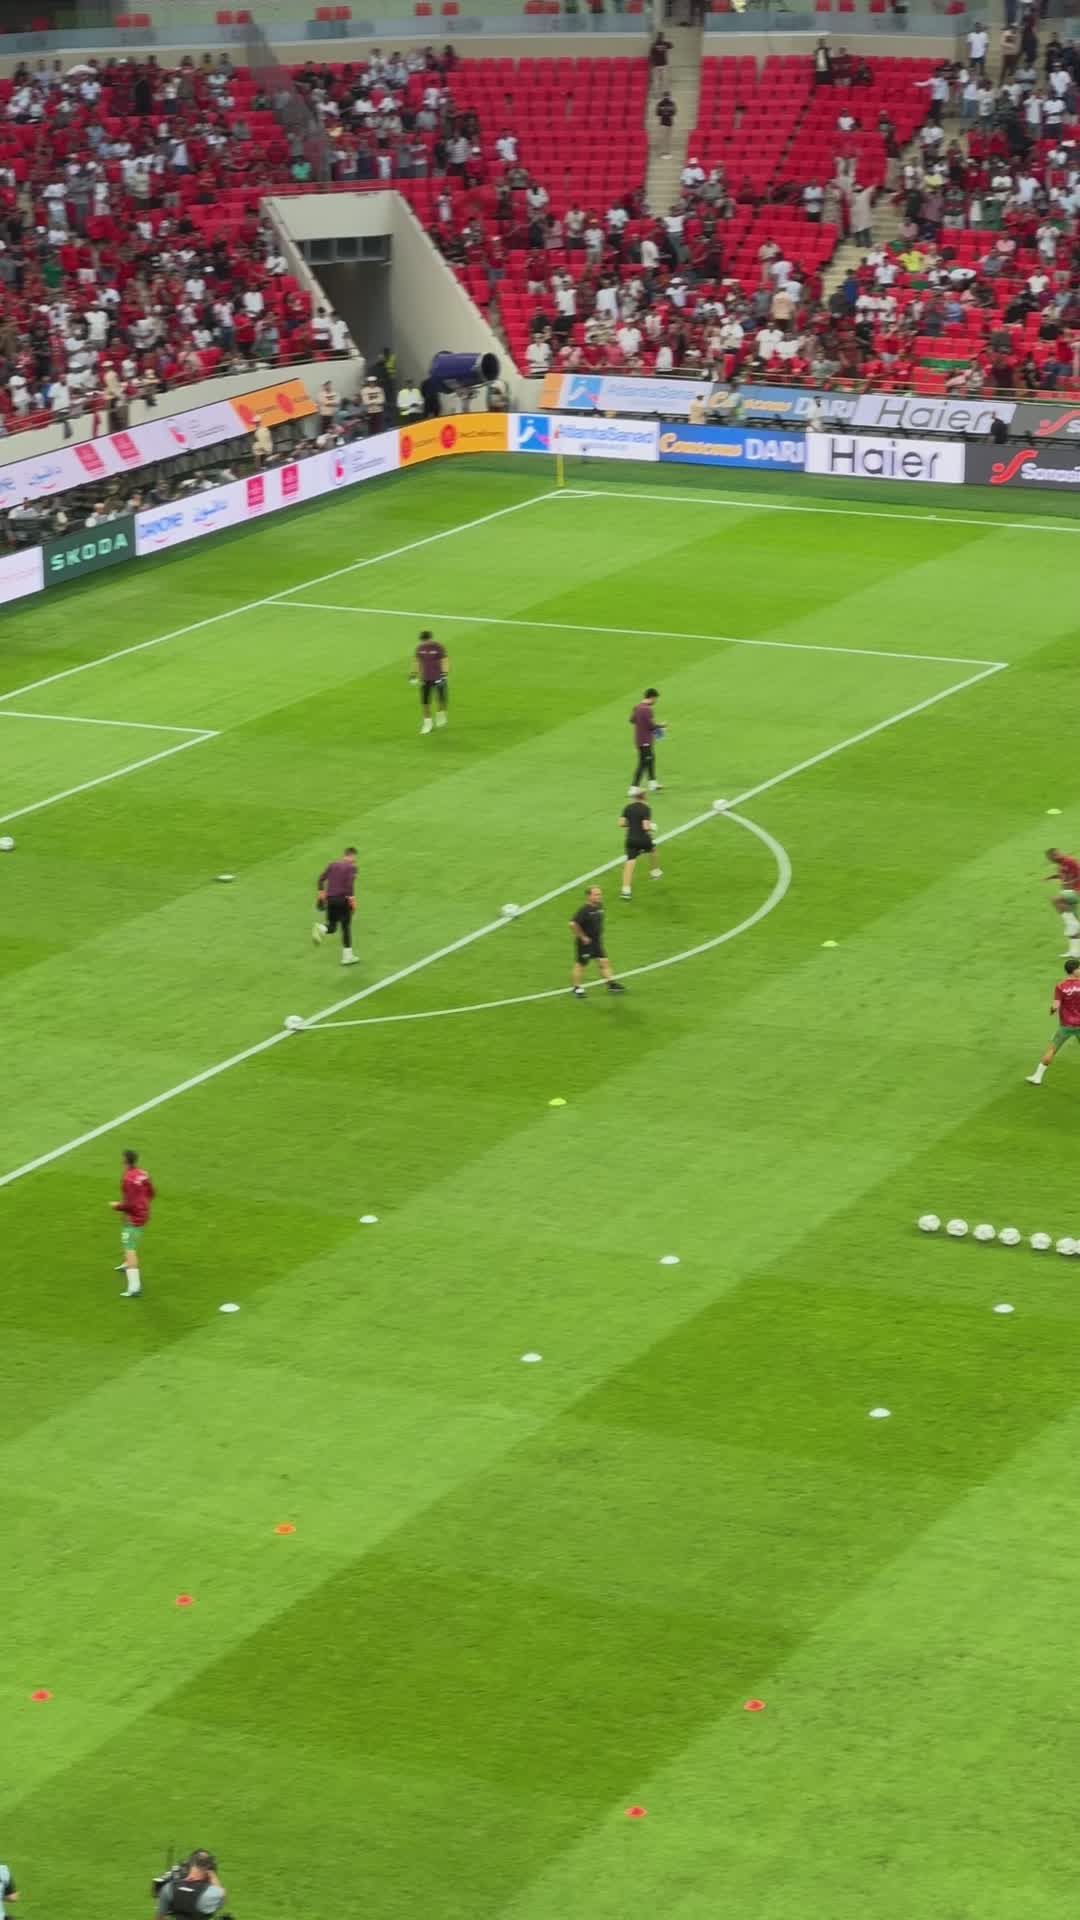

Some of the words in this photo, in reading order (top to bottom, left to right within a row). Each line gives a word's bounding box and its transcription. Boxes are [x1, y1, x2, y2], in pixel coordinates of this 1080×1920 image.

[876, 399, 994, 431] Haier
[744, 438, 806, 463] DARI
[829, 438, 939, 479] Haier
